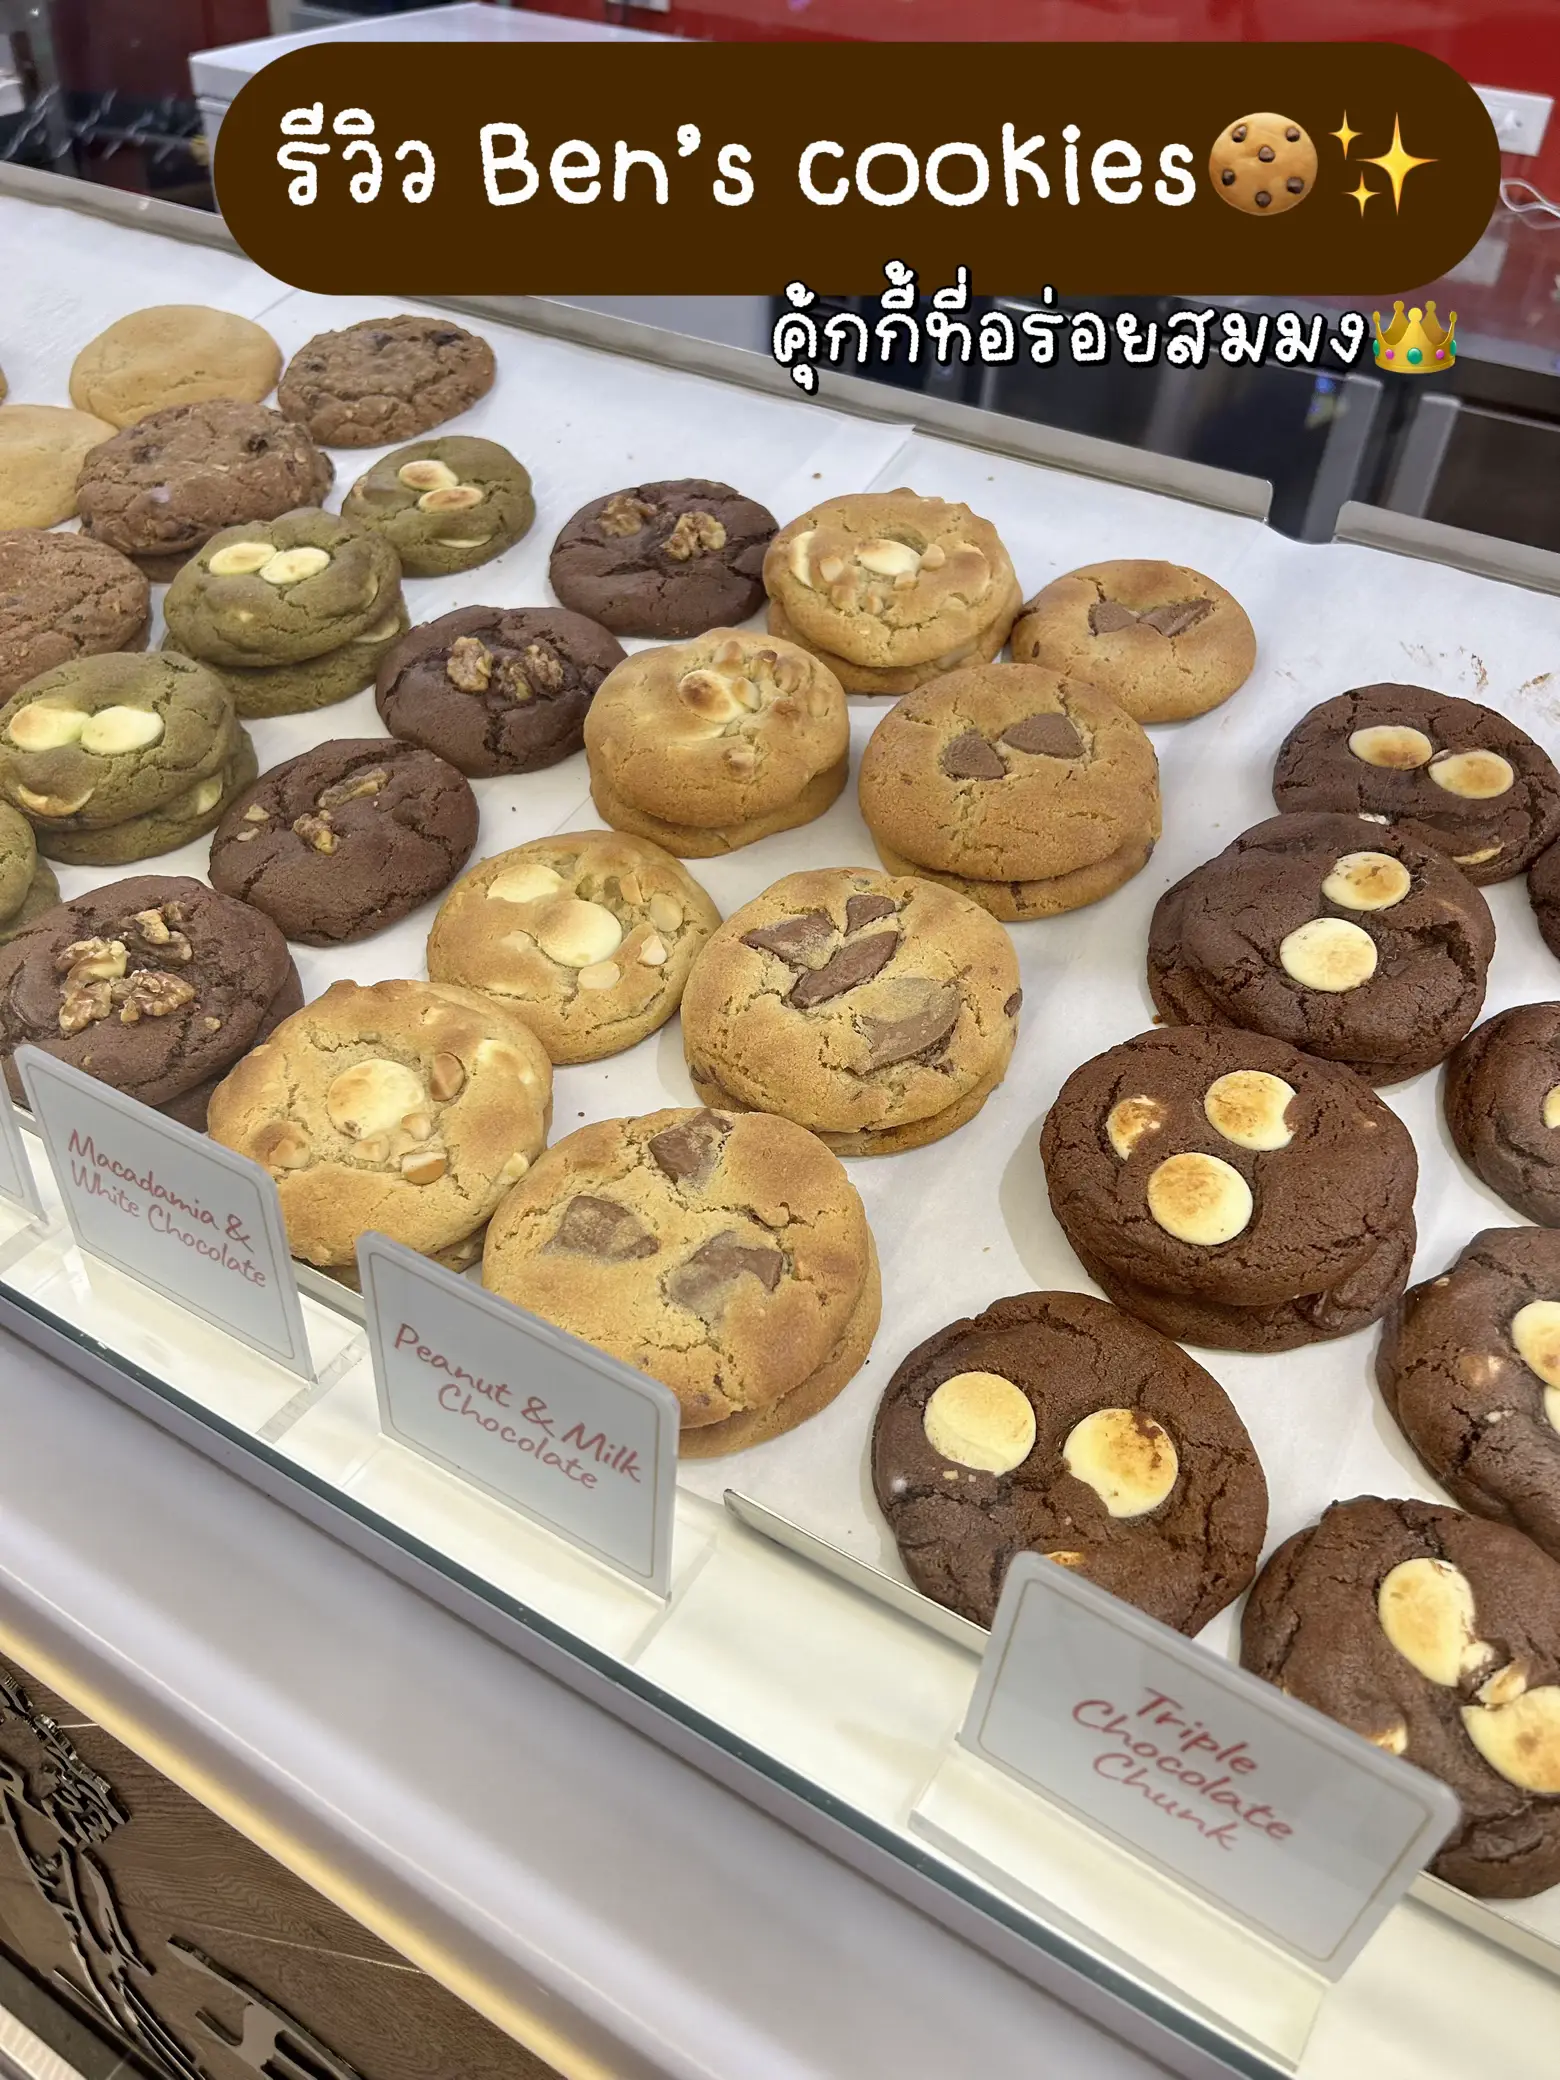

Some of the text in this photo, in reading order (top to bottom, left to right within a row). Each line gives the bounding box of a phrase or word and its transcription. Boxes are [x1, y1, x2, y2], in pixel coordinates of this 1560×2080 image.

[68, 1128, 256, 1254] Macadamia &
[70, 1158, 267, 1288] White Chocolate
[394, 1322, 641, 1484] Peanut & Milk
[438, 1385, 597, 1490] Chocolate
[1072, 1699, 1293, 1841] Chocolate
[1137, 1686, 1258, 1775] Triple
[1093, 1751, 1238, 1851] Chunk
